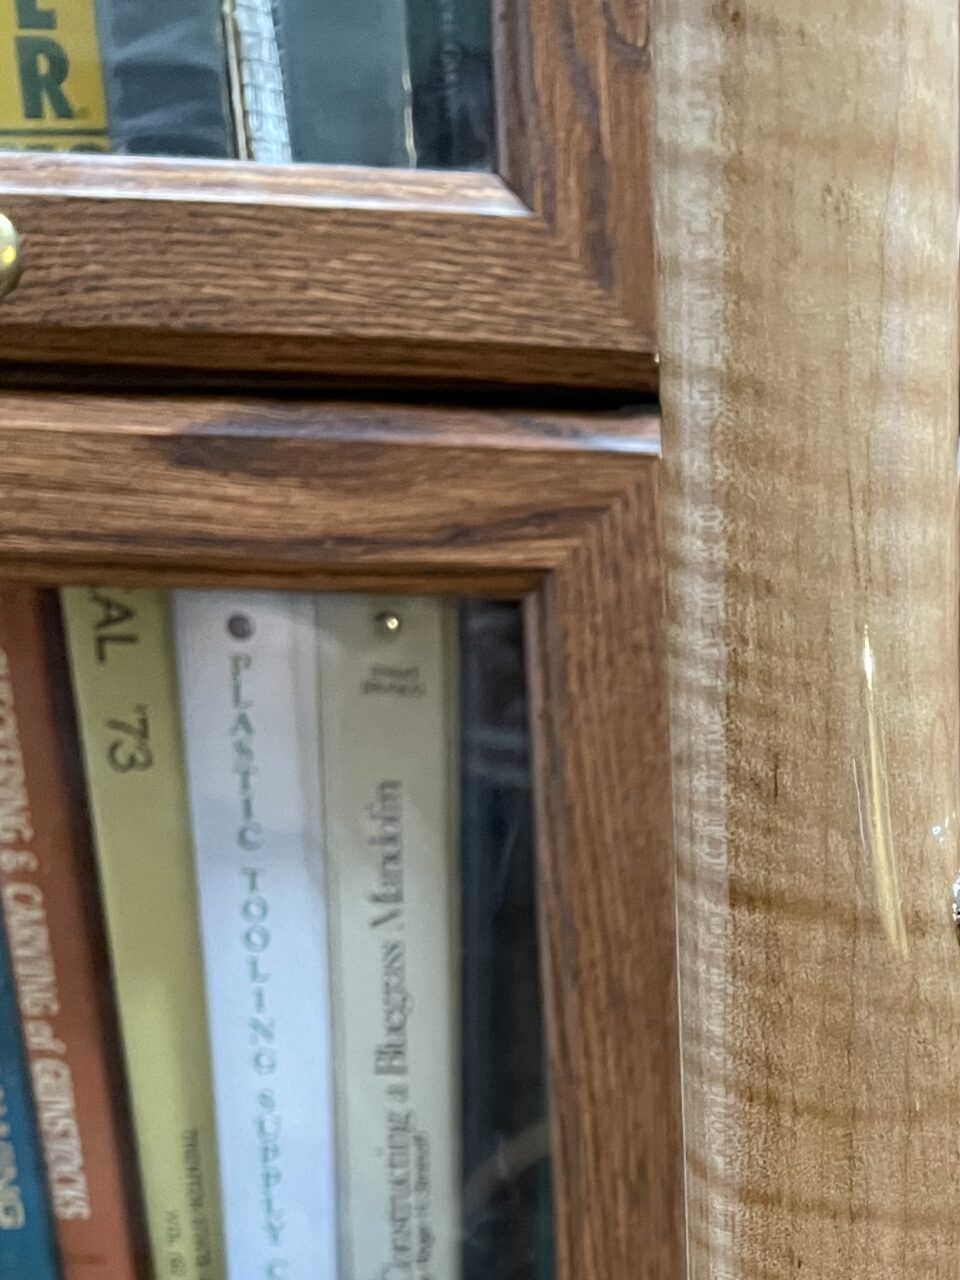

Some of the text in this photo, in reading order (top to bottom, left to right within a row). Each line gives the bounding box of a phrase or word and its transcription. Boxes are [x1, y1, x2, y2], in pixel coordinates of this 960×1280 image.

[231, 653, 264, 851] PLASTIC
[366, 780, 403, 931] Mandolin
[4, 882, 62, 1016] CARVING
[240, 866, 277, 1077] TOOLING
[374, 942, 414, 1076] Bluegrass
[256, 1088, 285, 1245] SUPPLY
[387, 1082, 409, 1102] a
